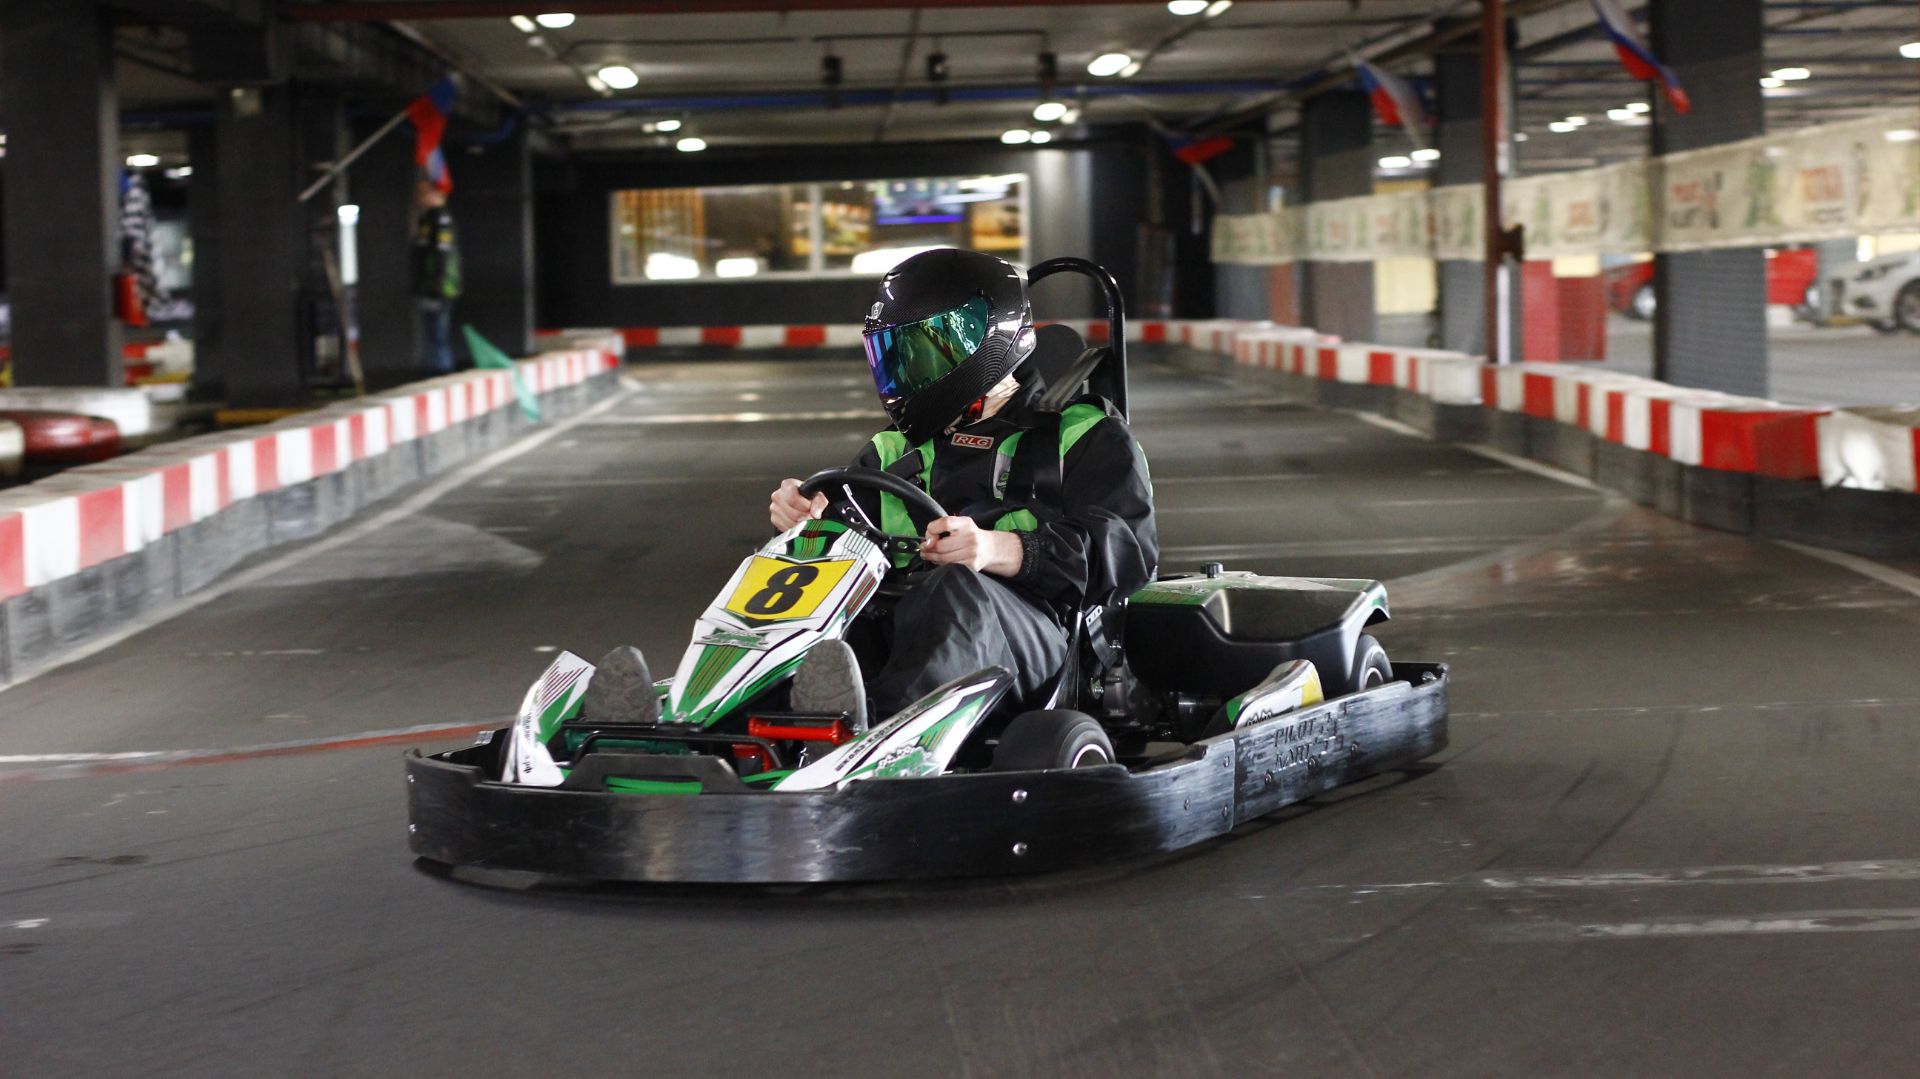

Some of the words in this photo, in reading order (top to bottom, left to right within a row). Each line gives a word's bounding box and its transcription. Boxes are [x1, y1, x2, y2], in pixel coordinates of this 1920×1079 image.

[956, 436, 989, 446] RLG
[744, 565, 819, 614] 8
[1274, 718, 1316, 747] PILOT
